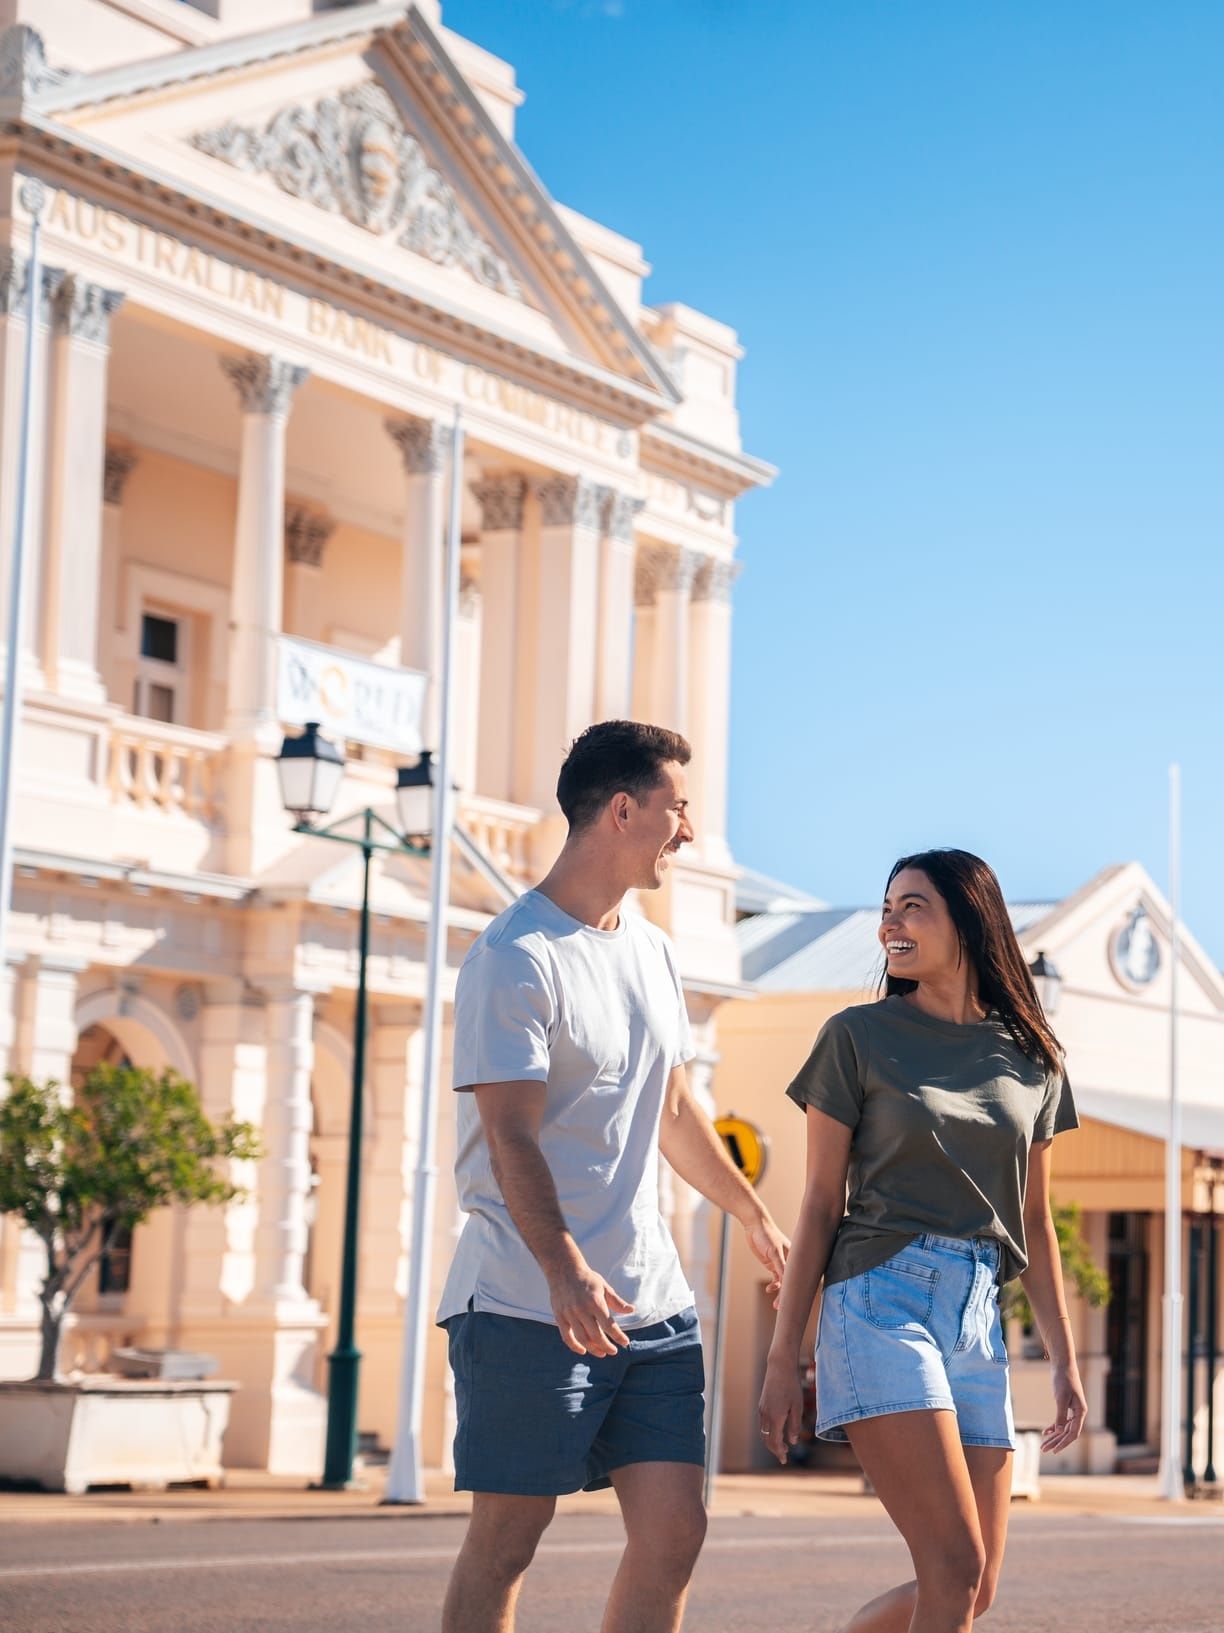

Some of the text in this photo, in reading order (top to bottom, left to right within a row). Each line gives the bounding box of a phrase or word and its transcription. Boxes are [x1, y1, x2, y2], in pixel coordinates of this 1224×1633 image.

[48, 188, 288, 320] AUSTRALIAN
[305, 298, 394, 366] BANK
[411, 343, 446, 384] OF
